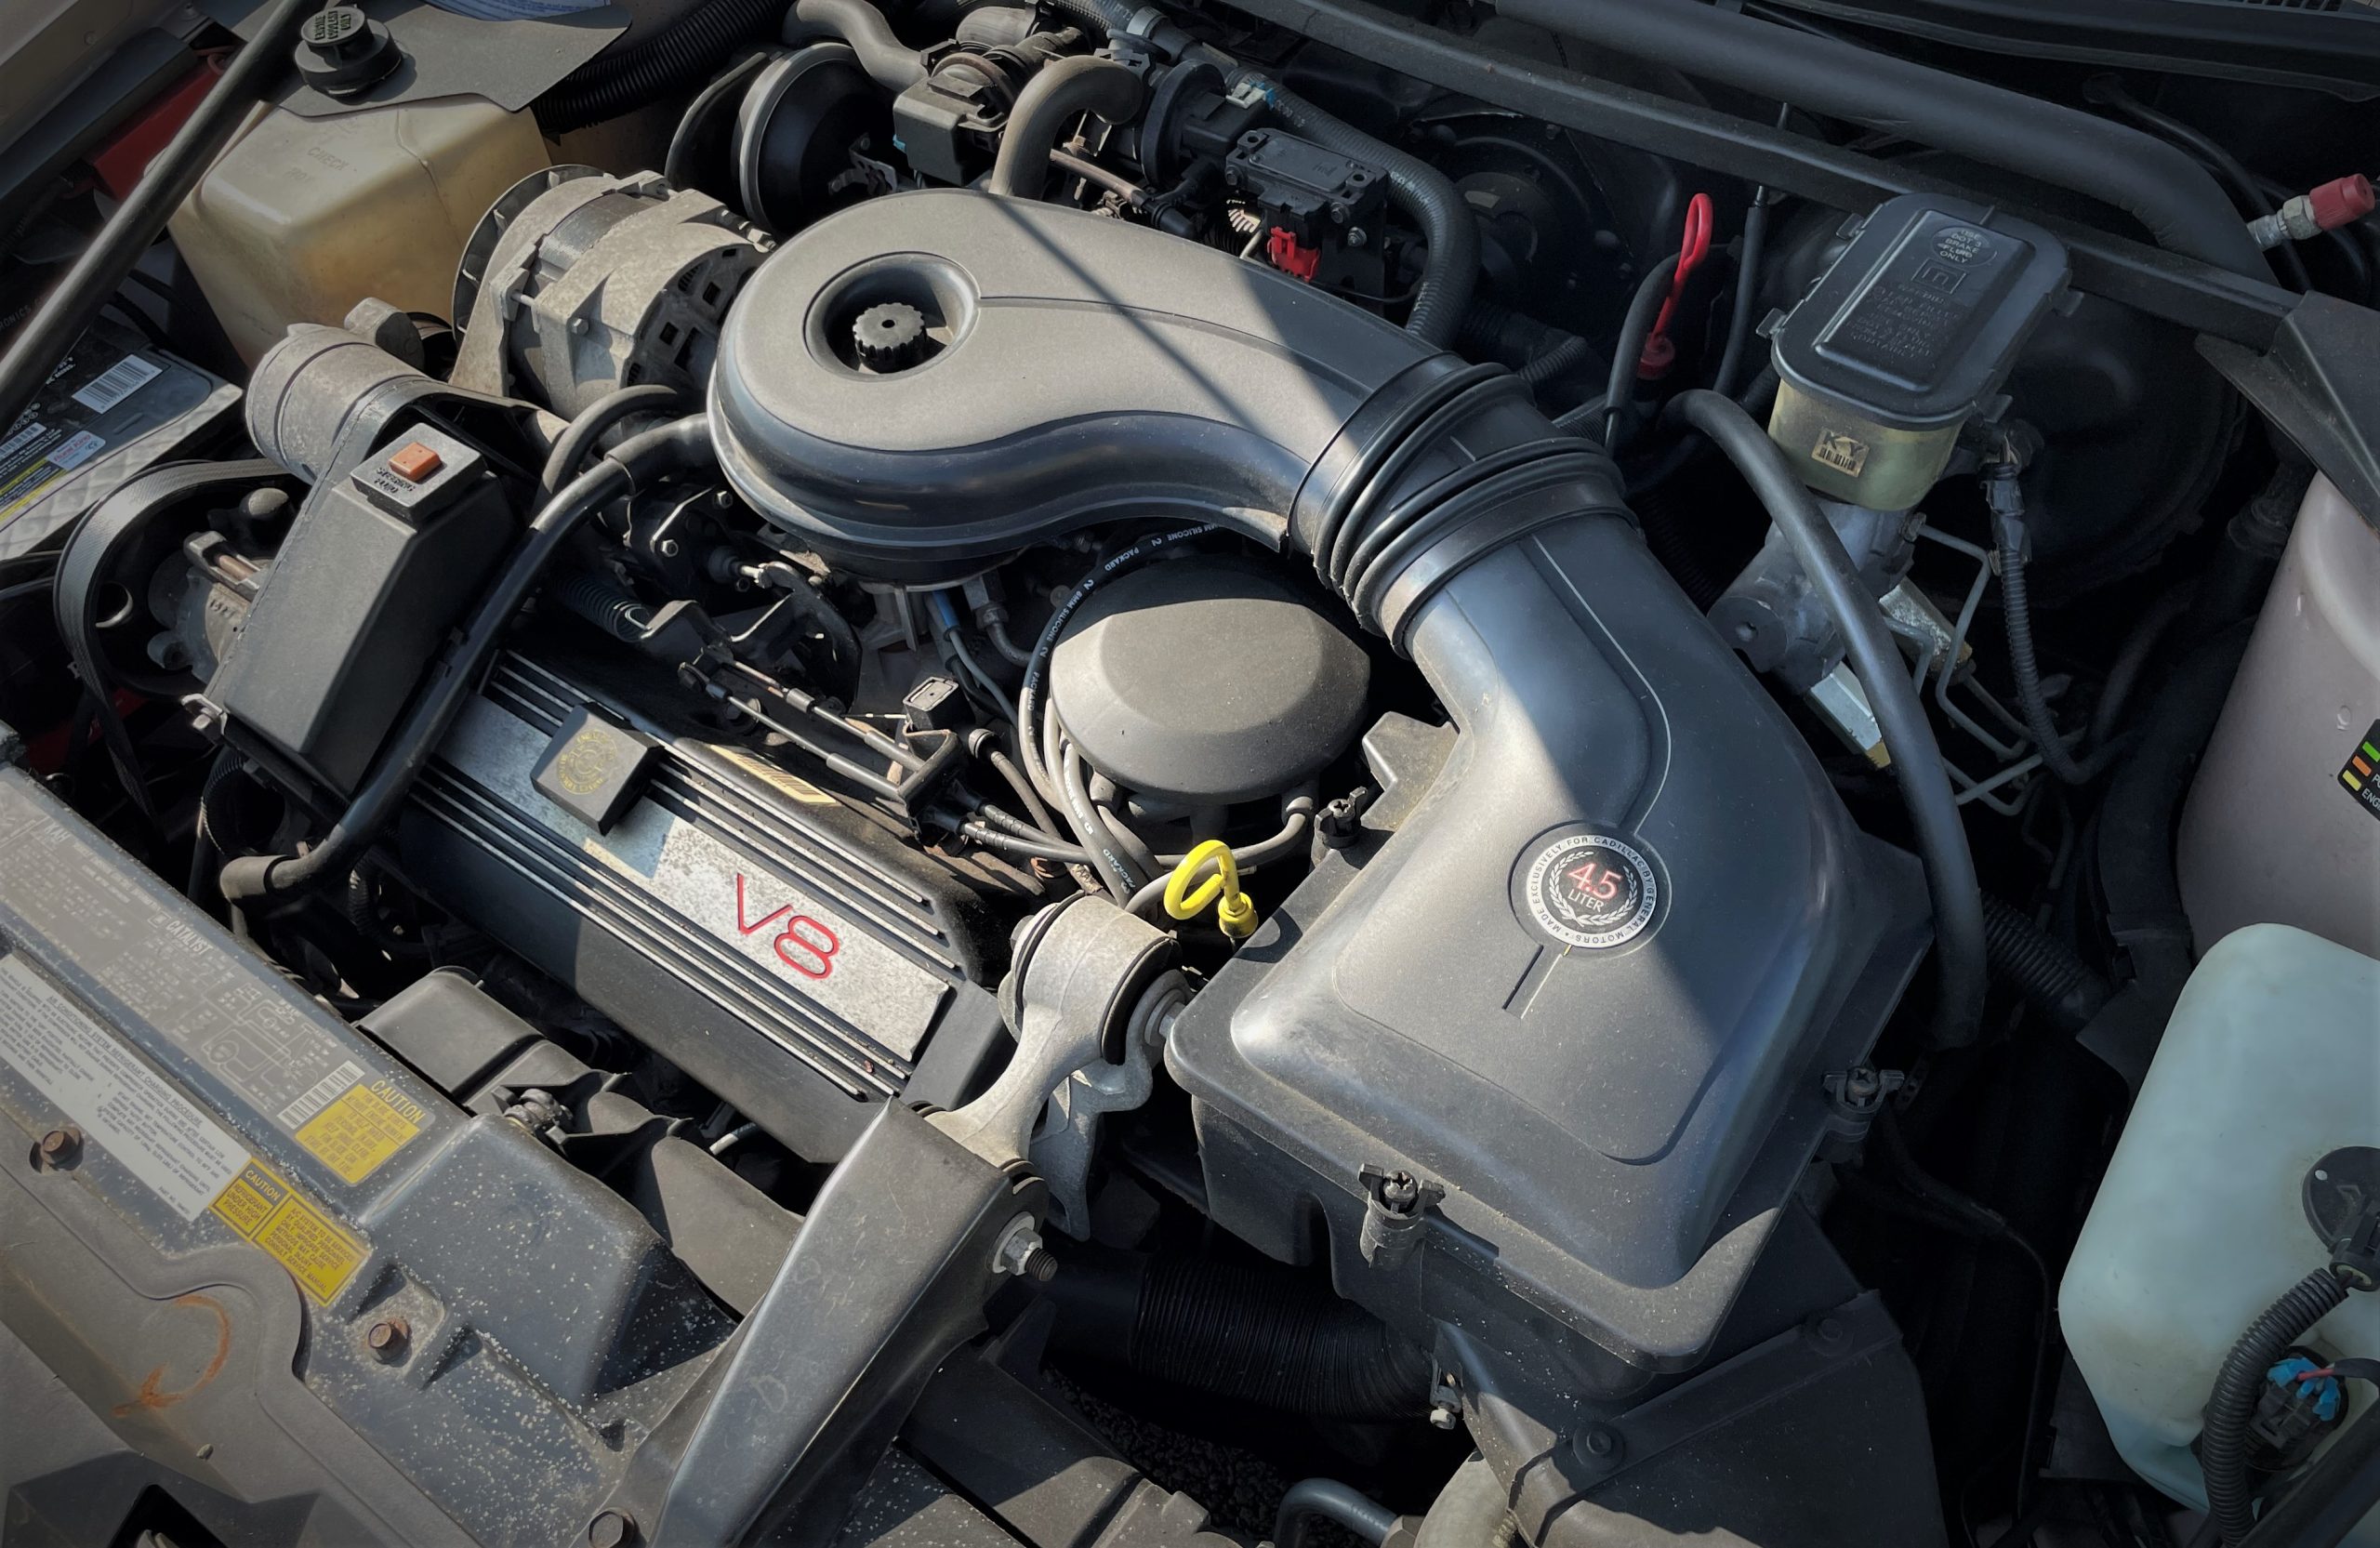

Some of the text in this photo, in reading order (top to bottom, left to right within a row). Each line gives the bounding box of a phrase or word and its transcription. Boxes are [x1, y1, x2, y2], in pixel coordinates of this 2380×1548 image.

[1945, 238, 1979, 254] BRAKE
[1951, 232, 1973, 244] DOT
[1940, 250, 1968, 264] ONLY
[1168, 526, 1203, 541] SILICONE
[1104, 547, 1139, 572] PACKARD
[1046, 608, 1069, 643] SILICONE
[1027, 671, 1040, 711] PACKARD
[1103, 848, 1136, 888] PACKARD
[1568, 863, 1623, 900] 4.5
[1532, 836, 1654, 944] MADE EXCLUSIVELY FOR CADILLAC BY GENERAL MOTORS
[1567, 888, 1605, 912] LITER
[165, 920, 214, 956] CATALYST
[735, 872, 840, 981] V8
[55, 1001, 93, 1035] CONDITIONING
[89, 1030, 112, 1052] SYSTEM
[109, 1047, 145, 1079] REFRIGERANT
[142, 1075, 172, 1102] CHARGING
[169, 1097, 203, 1128] PROCEDURE
[371, 1079, 426, 1124] CAUTION
[231, 1183, 268, 1213] REFRIGERANT
[245, 1170, 281, 1202] CAUTION
[222, 1198, 253, 1225] PRESSURE
[225, 1189, 261, 1221] UNDER HIGH
